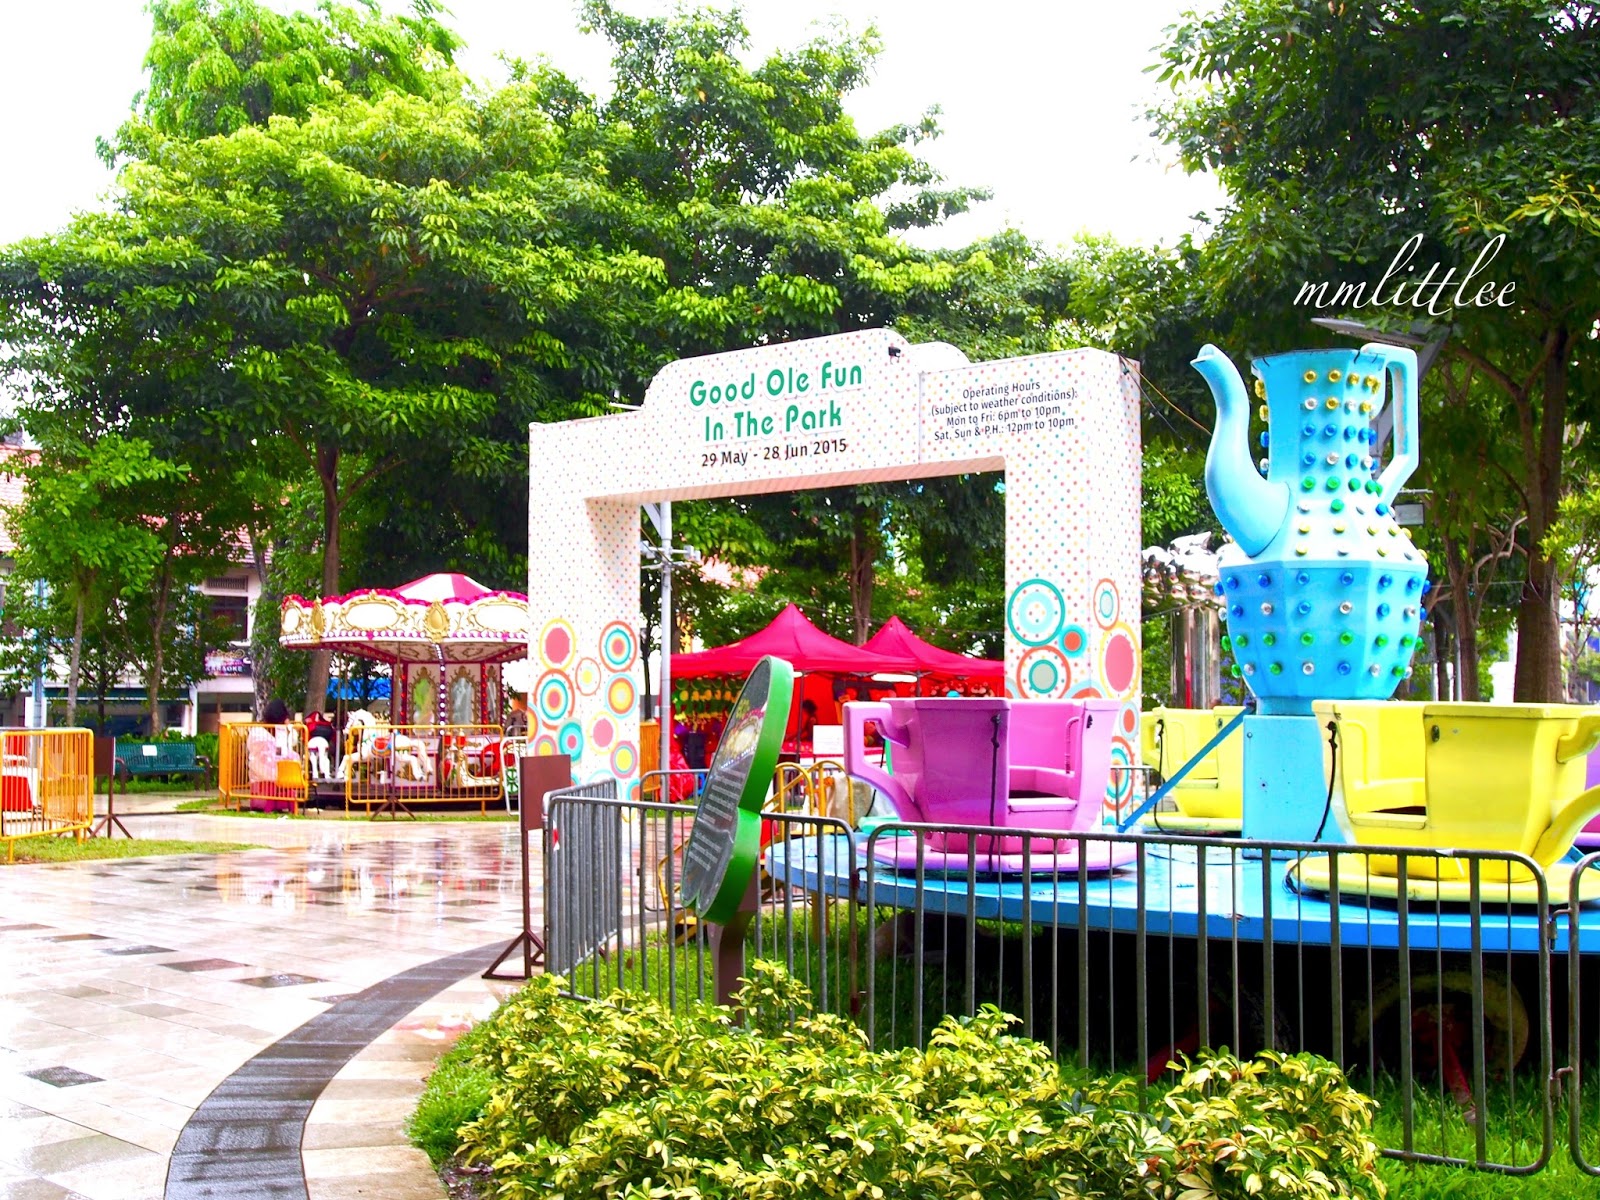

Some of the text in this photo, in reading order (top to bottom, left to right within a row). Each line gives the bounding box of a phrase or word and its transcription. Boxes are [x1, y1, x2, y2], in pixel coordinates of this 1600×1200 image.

[690, 361, 862, 406] Good Ole Fun
[963, 381, 1041, 400] Operating Hours
[931, 404, 967, 417] (subject
[970, 402, 979, 411] to
[981, 397, 1019, 410] weather
[946, 405, 1061, 427] Mon to Fri: 6pm to 10pm
[705, 400, 842, 441] In The Park
[954, 428, 972, 440] Sun
[974, 426, 981, 437] &
[1007, 421, 1032, 434] 12pm
[1035, 420, 1045, 430] to
[1048, 416, 1075, 431] 10pm
[701, 453, 718, 467] 29
[721, 451, 748, 466] May
[763, 446, 780, 460] 28
[785, 444, 808, 460] Jun
[813, 438, 847, 455] 2015
